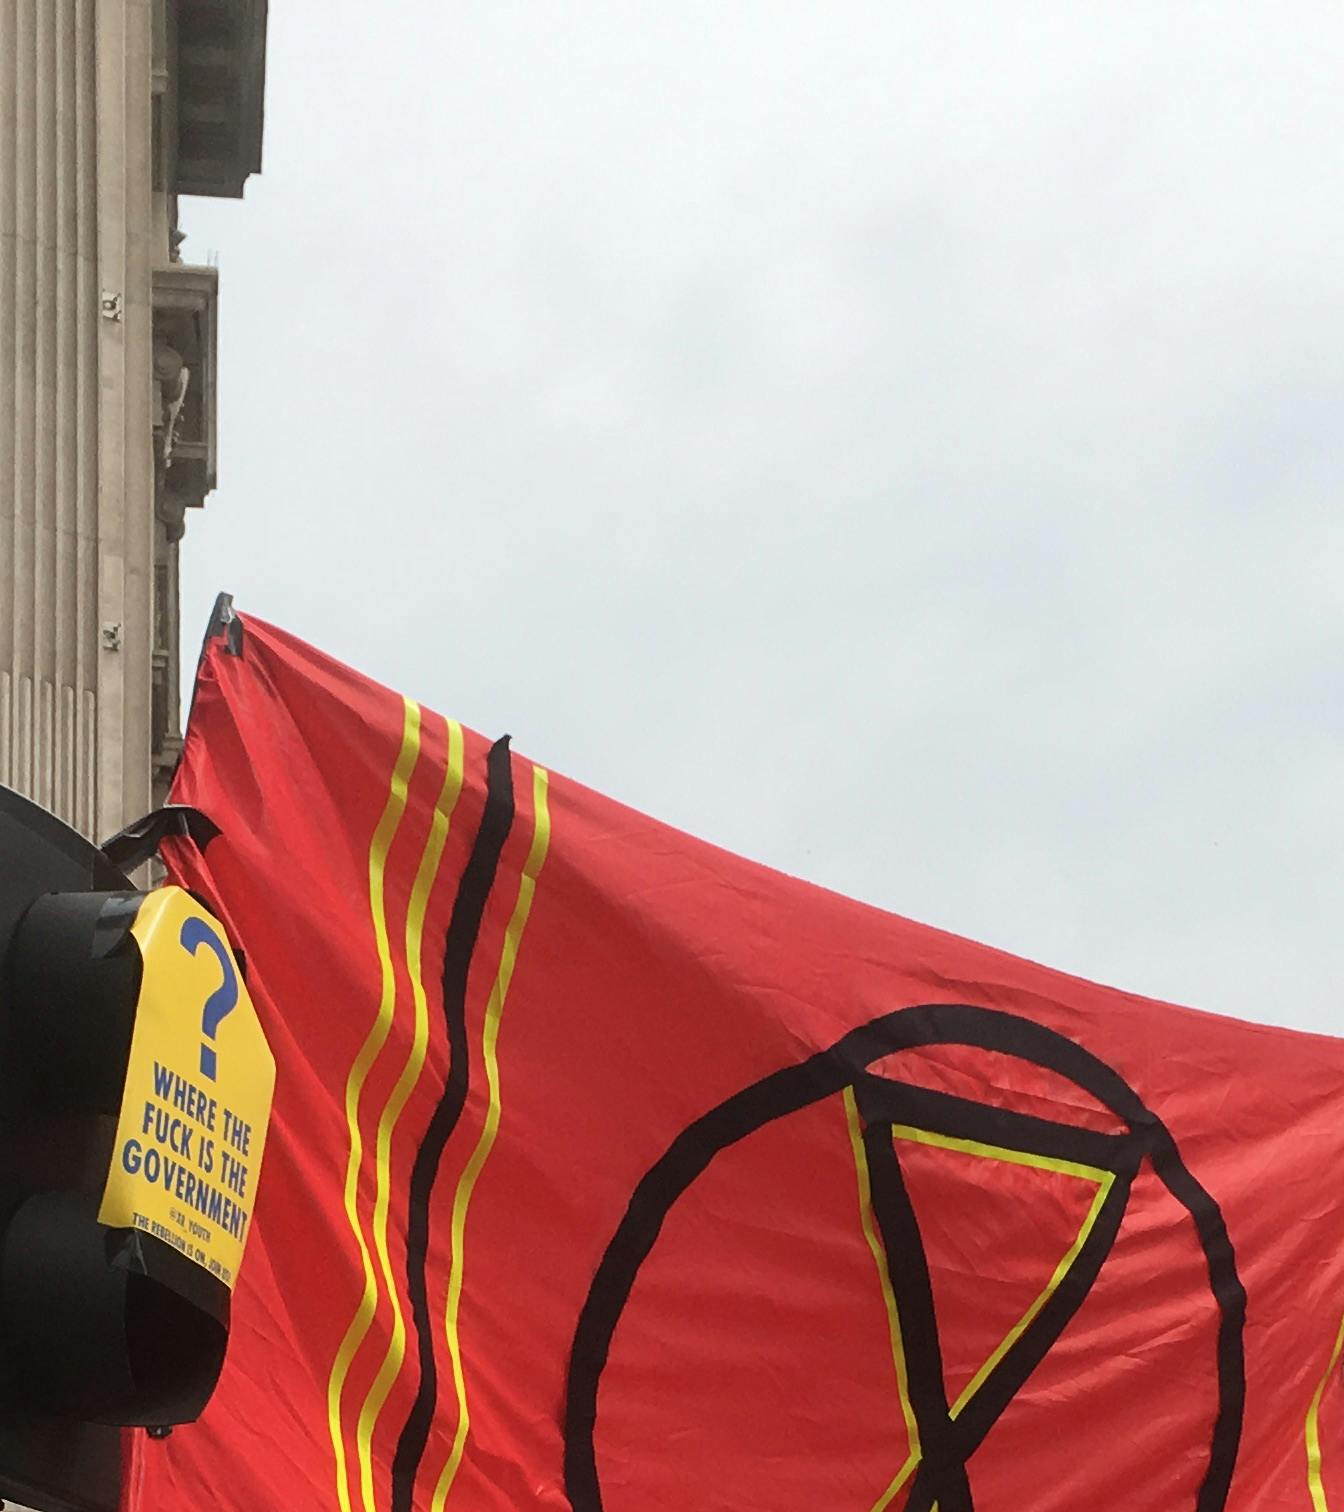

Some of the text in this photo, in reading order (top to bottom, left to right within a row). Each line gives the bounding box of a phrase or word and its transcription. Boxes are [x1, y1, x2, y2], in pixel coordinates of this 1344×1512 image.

[179, 916, 239, 1083] ?
[142, 1101, 249, 1199] FUCK IS THE
[153, 1060, 252, 1158] WHERE THE
[121, 1138, 249, 1243] GOVERNMENT
[132, 1212, 150, 1230] THE
